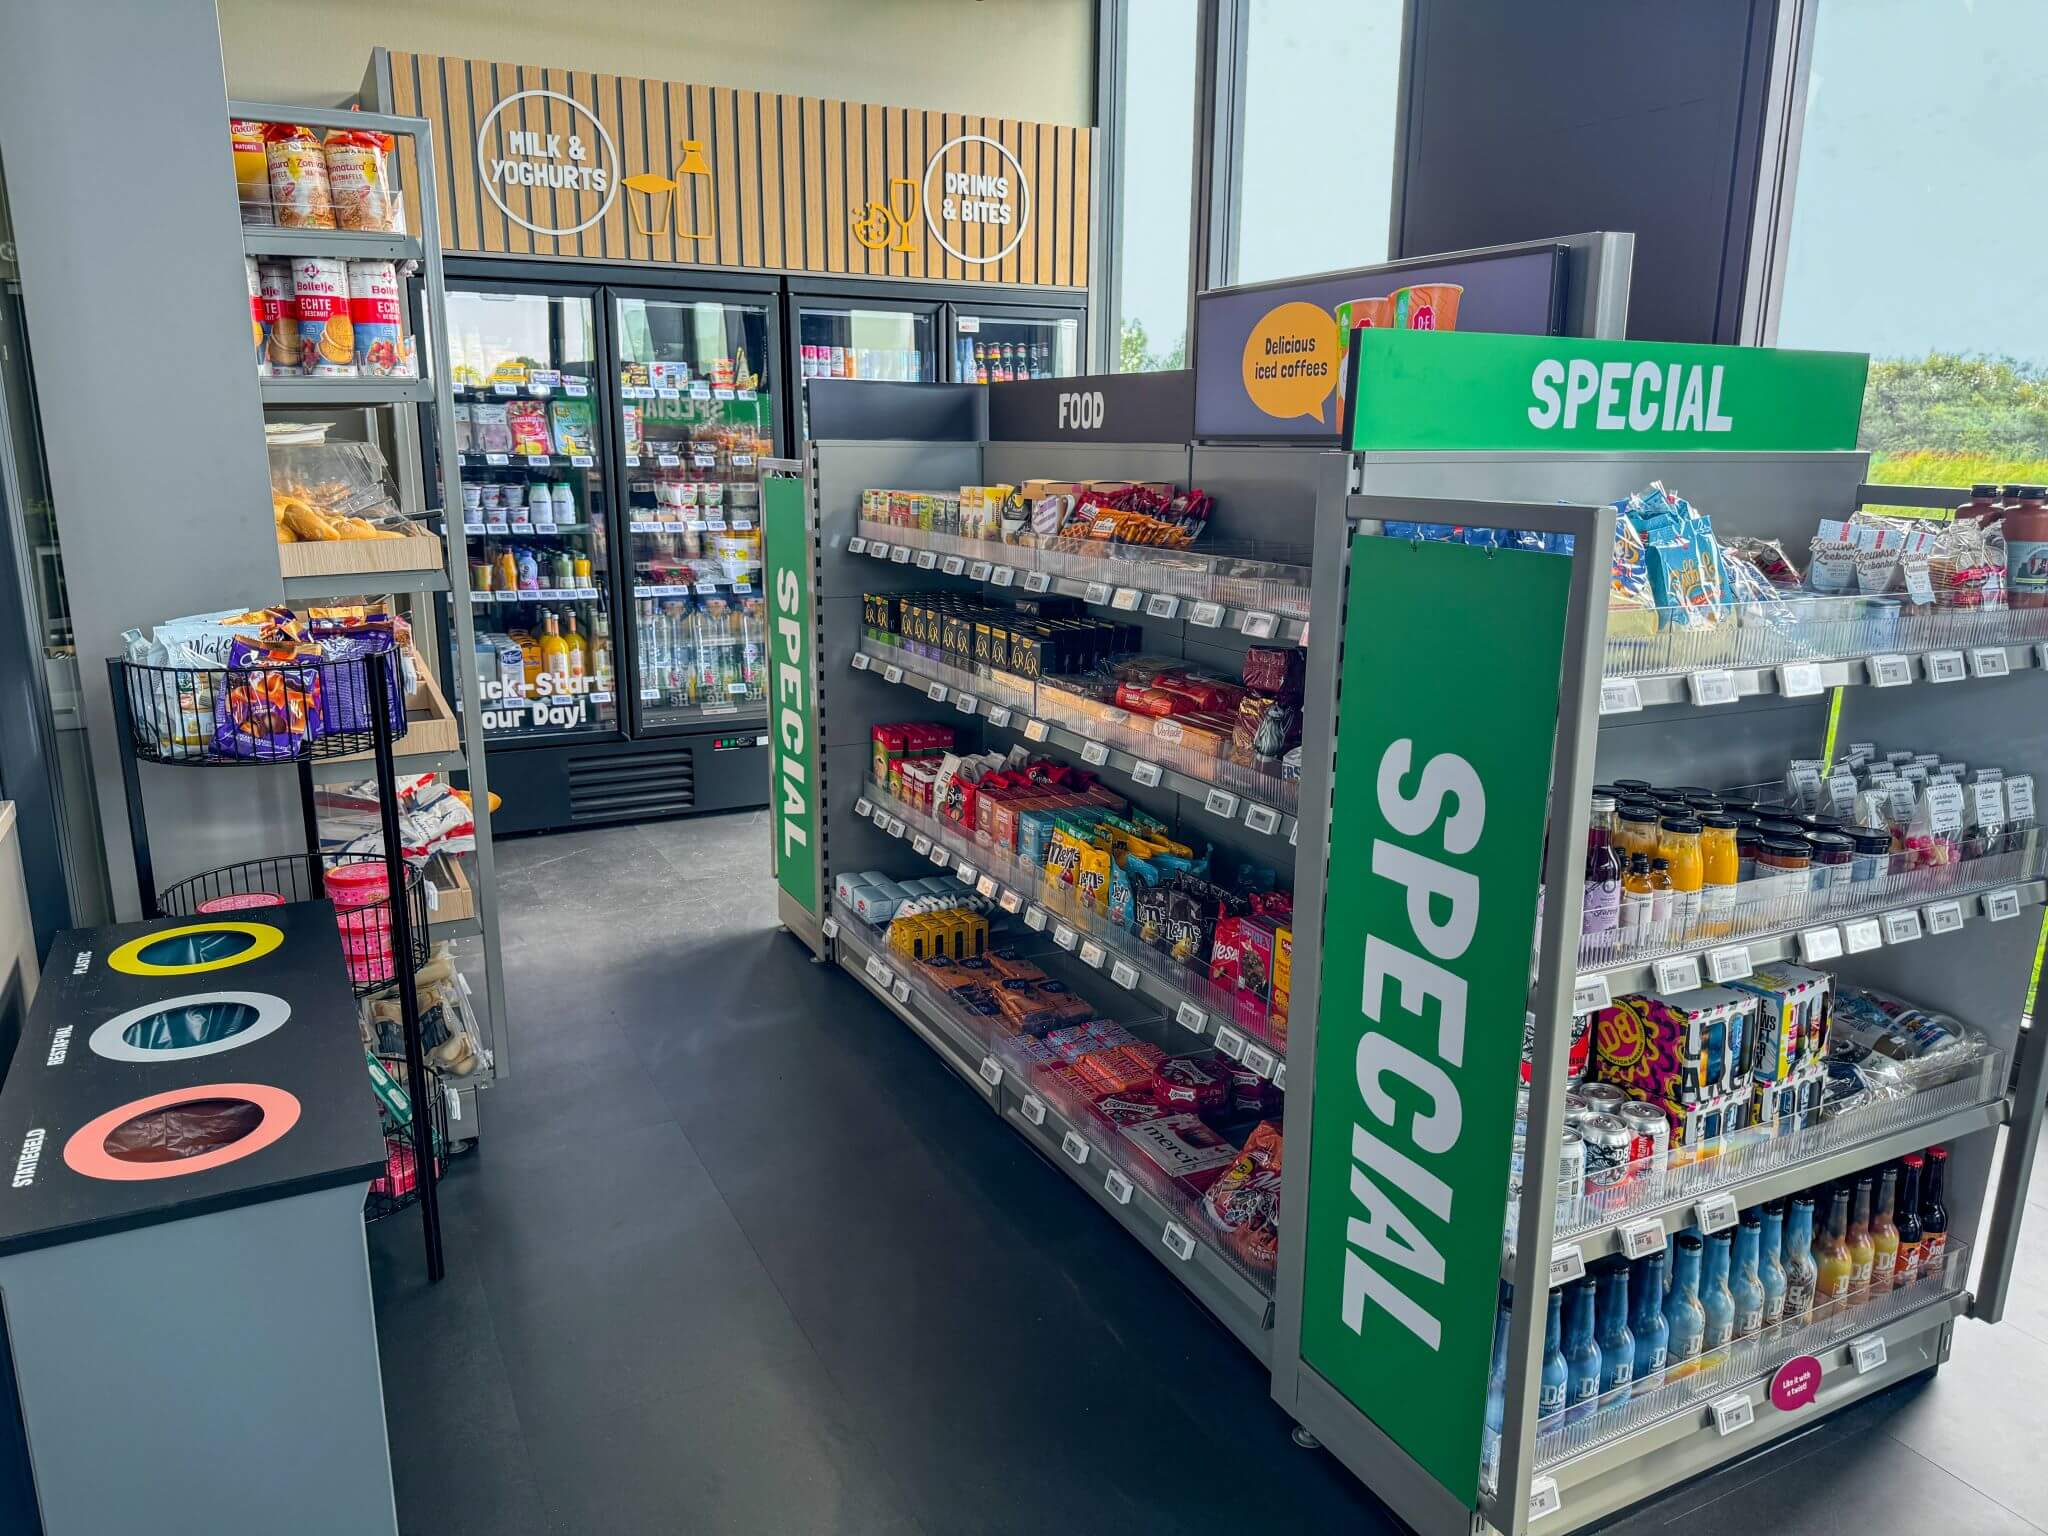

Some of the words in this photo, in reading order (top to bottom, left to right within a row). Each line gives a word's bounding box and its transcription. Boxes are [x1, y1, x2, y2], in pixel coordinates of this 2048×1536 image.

[509, 130, 562, 158] MILK
[568, 135, 587, 160] &
[491, 159, 607, 192] YOGHURTS
[945, 172, 1009, 199] DRINKS
[943, 198, 957, 220] &
[961, 199, 1011, 225] BITES
[301, 297, 332, 311] ECHTE
[1264, 337, 1316, 356] Delicious
[1254, 363, 1277, 380] iced
[1280, 360, 1328, 379] coffees
[1527, 357, 1733, 432] SPECIAL
[1058, 391, 1104, 429] FOOD
[480, 672, 610, 700] ick-Start
[481, 708, 526, 730] our
[533, 699, 588, 729] Day!
[776, 567, 807, 859] SPECIAL
[72, 950, 94, 976] PLASTIC
[46, 1023, 74, 1067] RESTAFVAL
[1341, 737, 1486, 1353] SPECIAL
[11, 1127, 47, 1189] STATIEGELD
[1143, 1124, 1199, 1165] merci
[1782, 1378, 1794, 1389] Like
[1794, 1376, 1800, 1385] it
[1799, 1371, 1812, 1384] with
